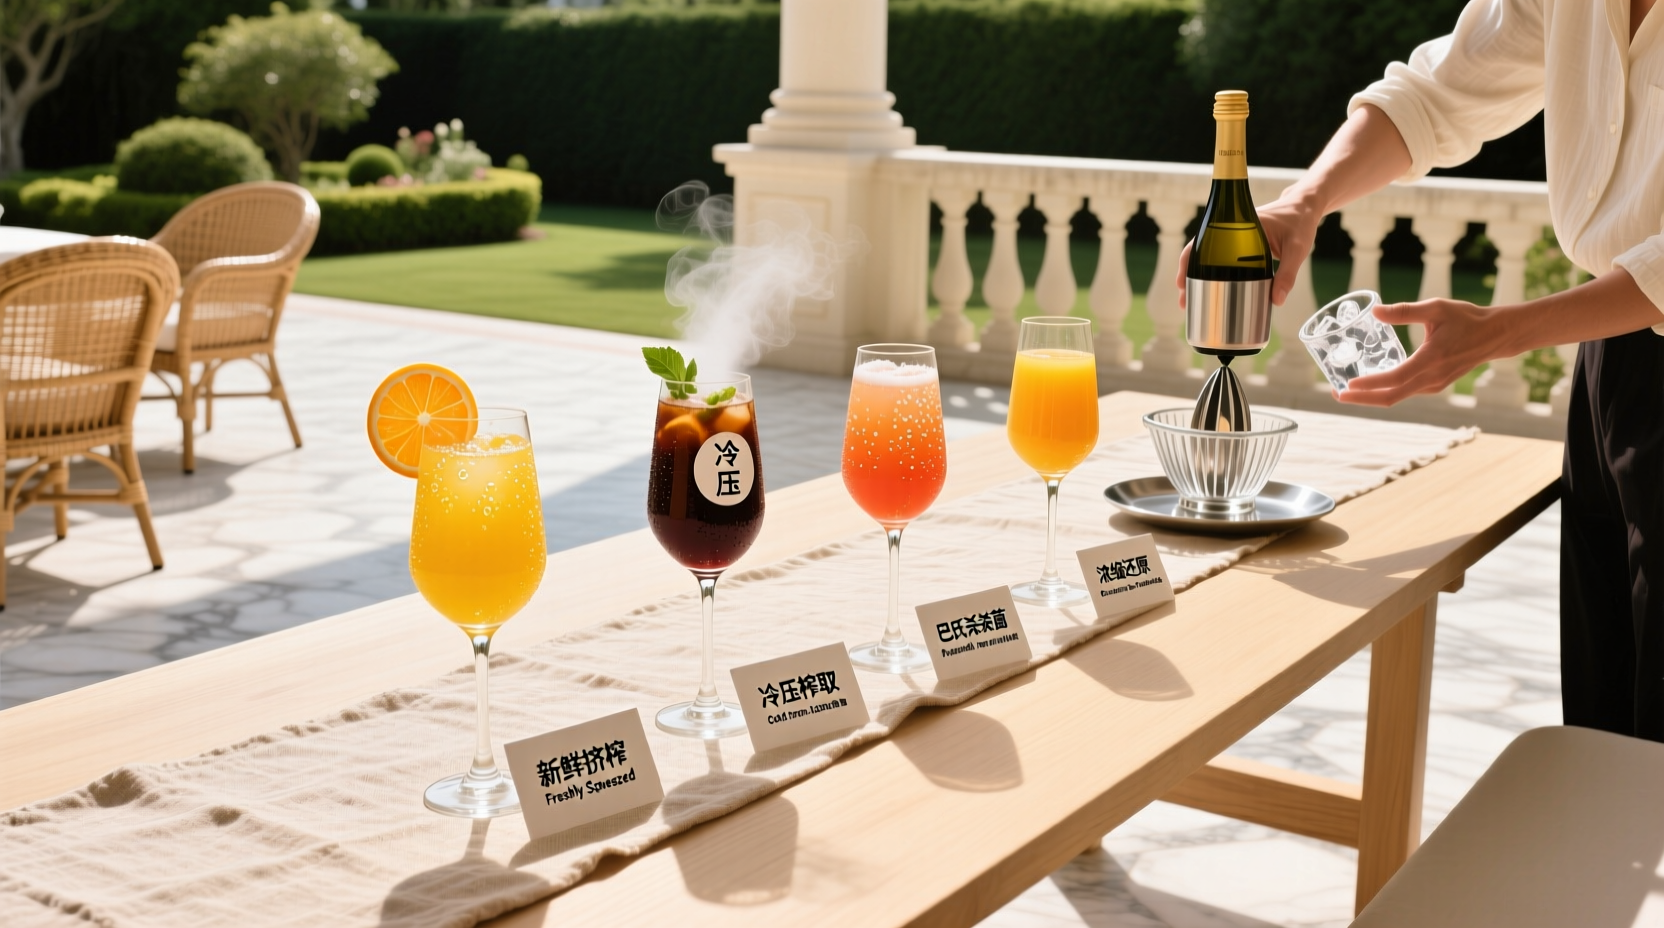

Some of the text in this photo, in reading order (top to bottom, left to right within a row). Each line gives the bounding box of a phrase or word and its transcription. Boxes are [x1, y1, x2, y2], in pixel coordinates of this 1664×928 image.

[714, 439, 741, 497] 冷压
[757, 670, 840, 708] 冷压榨取
[536, 740, 627, 787] 新鲜挤榨
[545, 784, 583, 806] Freshly
